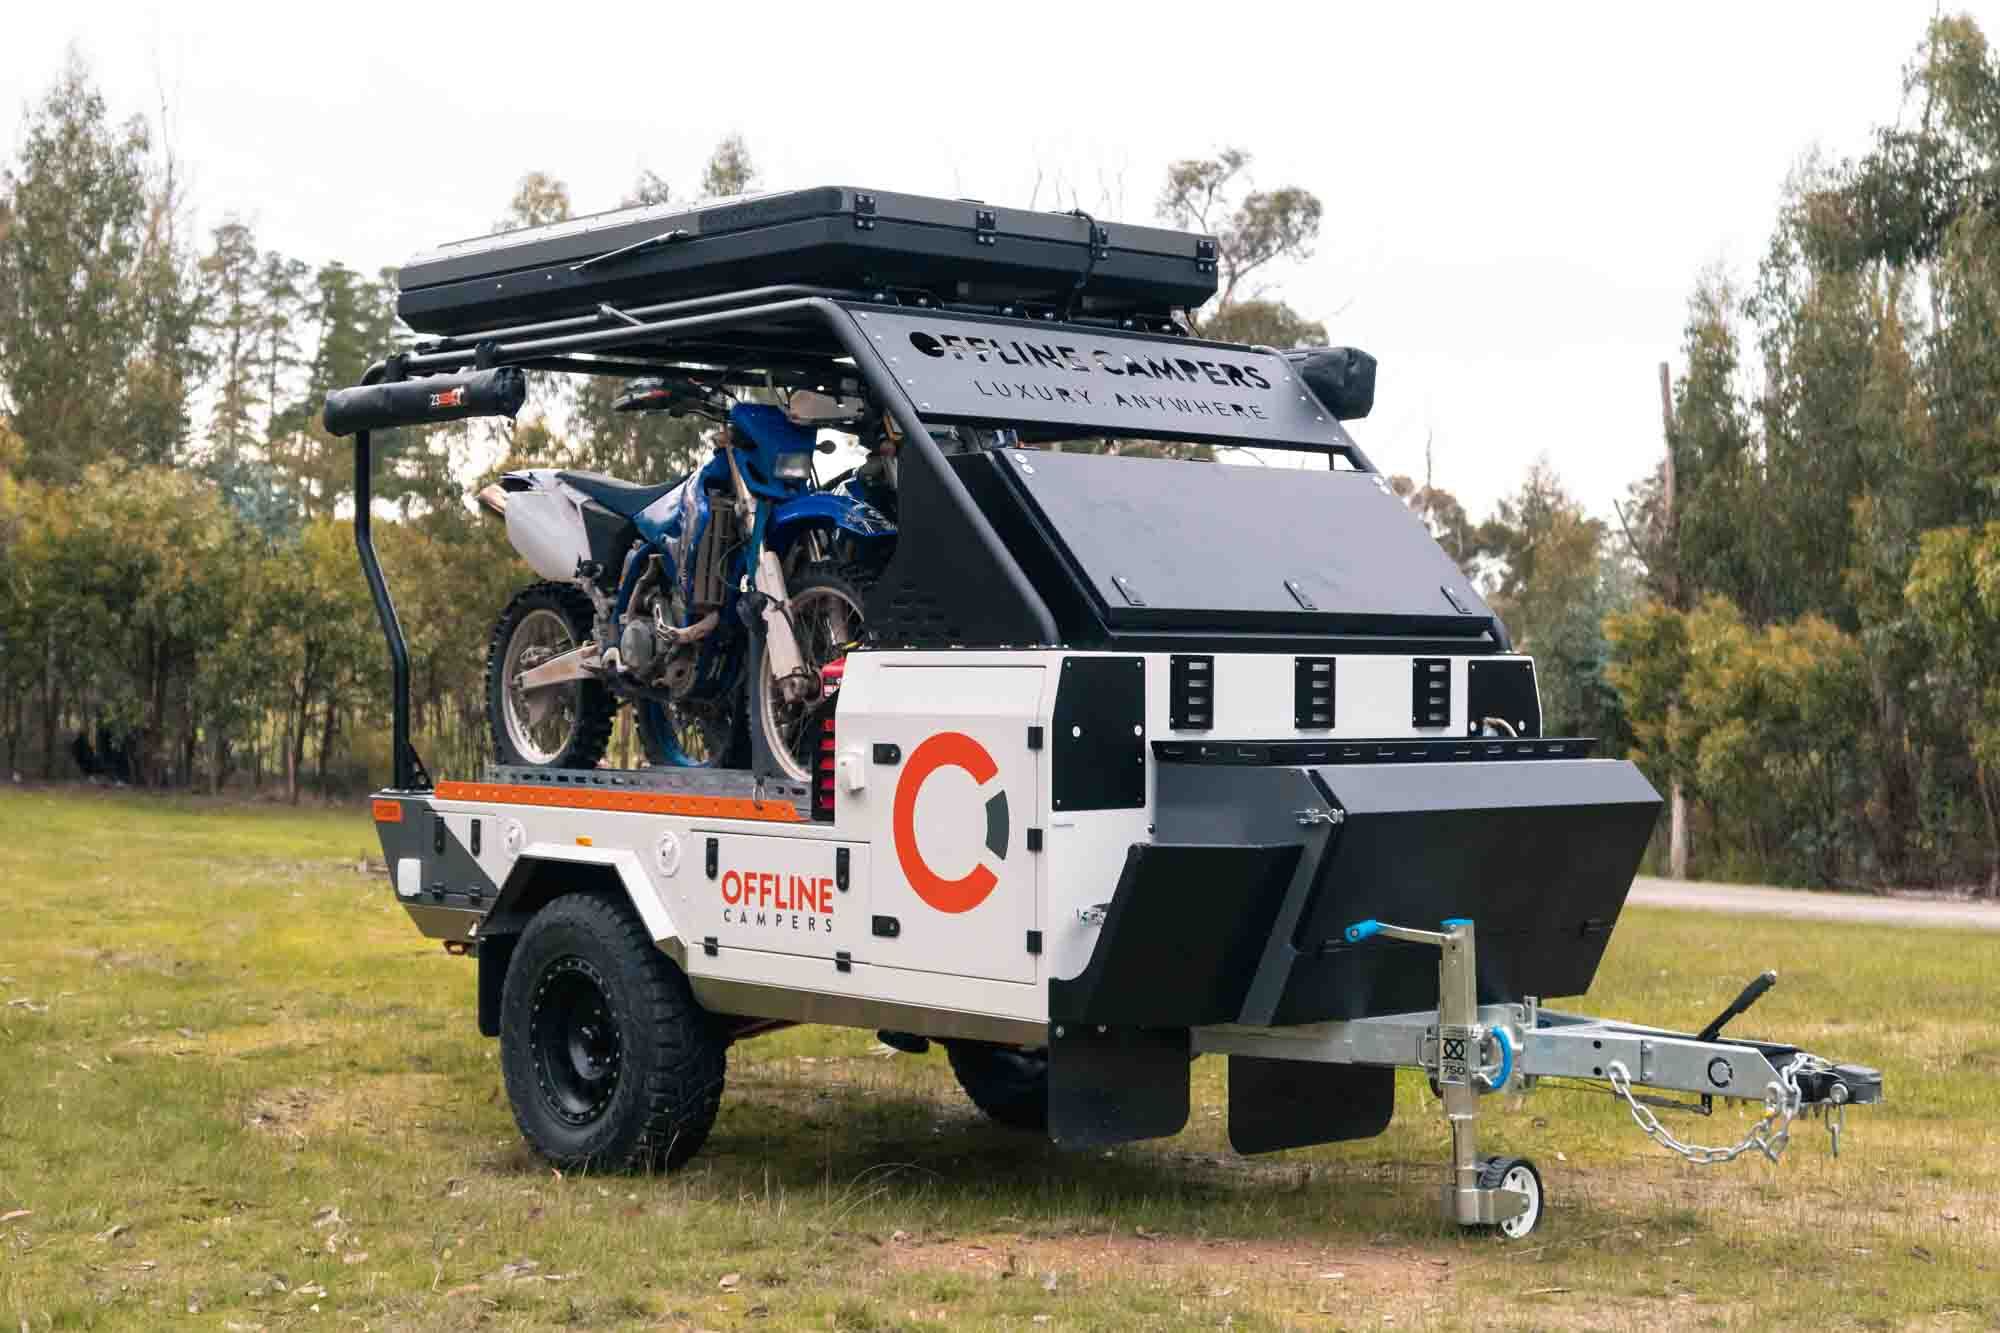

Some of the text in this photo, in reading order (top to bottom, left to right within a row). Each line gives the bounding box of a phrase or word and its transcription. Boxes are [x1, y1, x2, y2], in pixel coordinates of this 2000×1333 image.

[909, 331, 1272, 390] OFFLINE CAMPERS
[1115, 392, 1269, 419] ANYWHERE
[721, 869, 834, 914] OFFLINE
[723, 909, 833, 933] CAMPERS
[1442, 1065, 1465, 1075] 750
